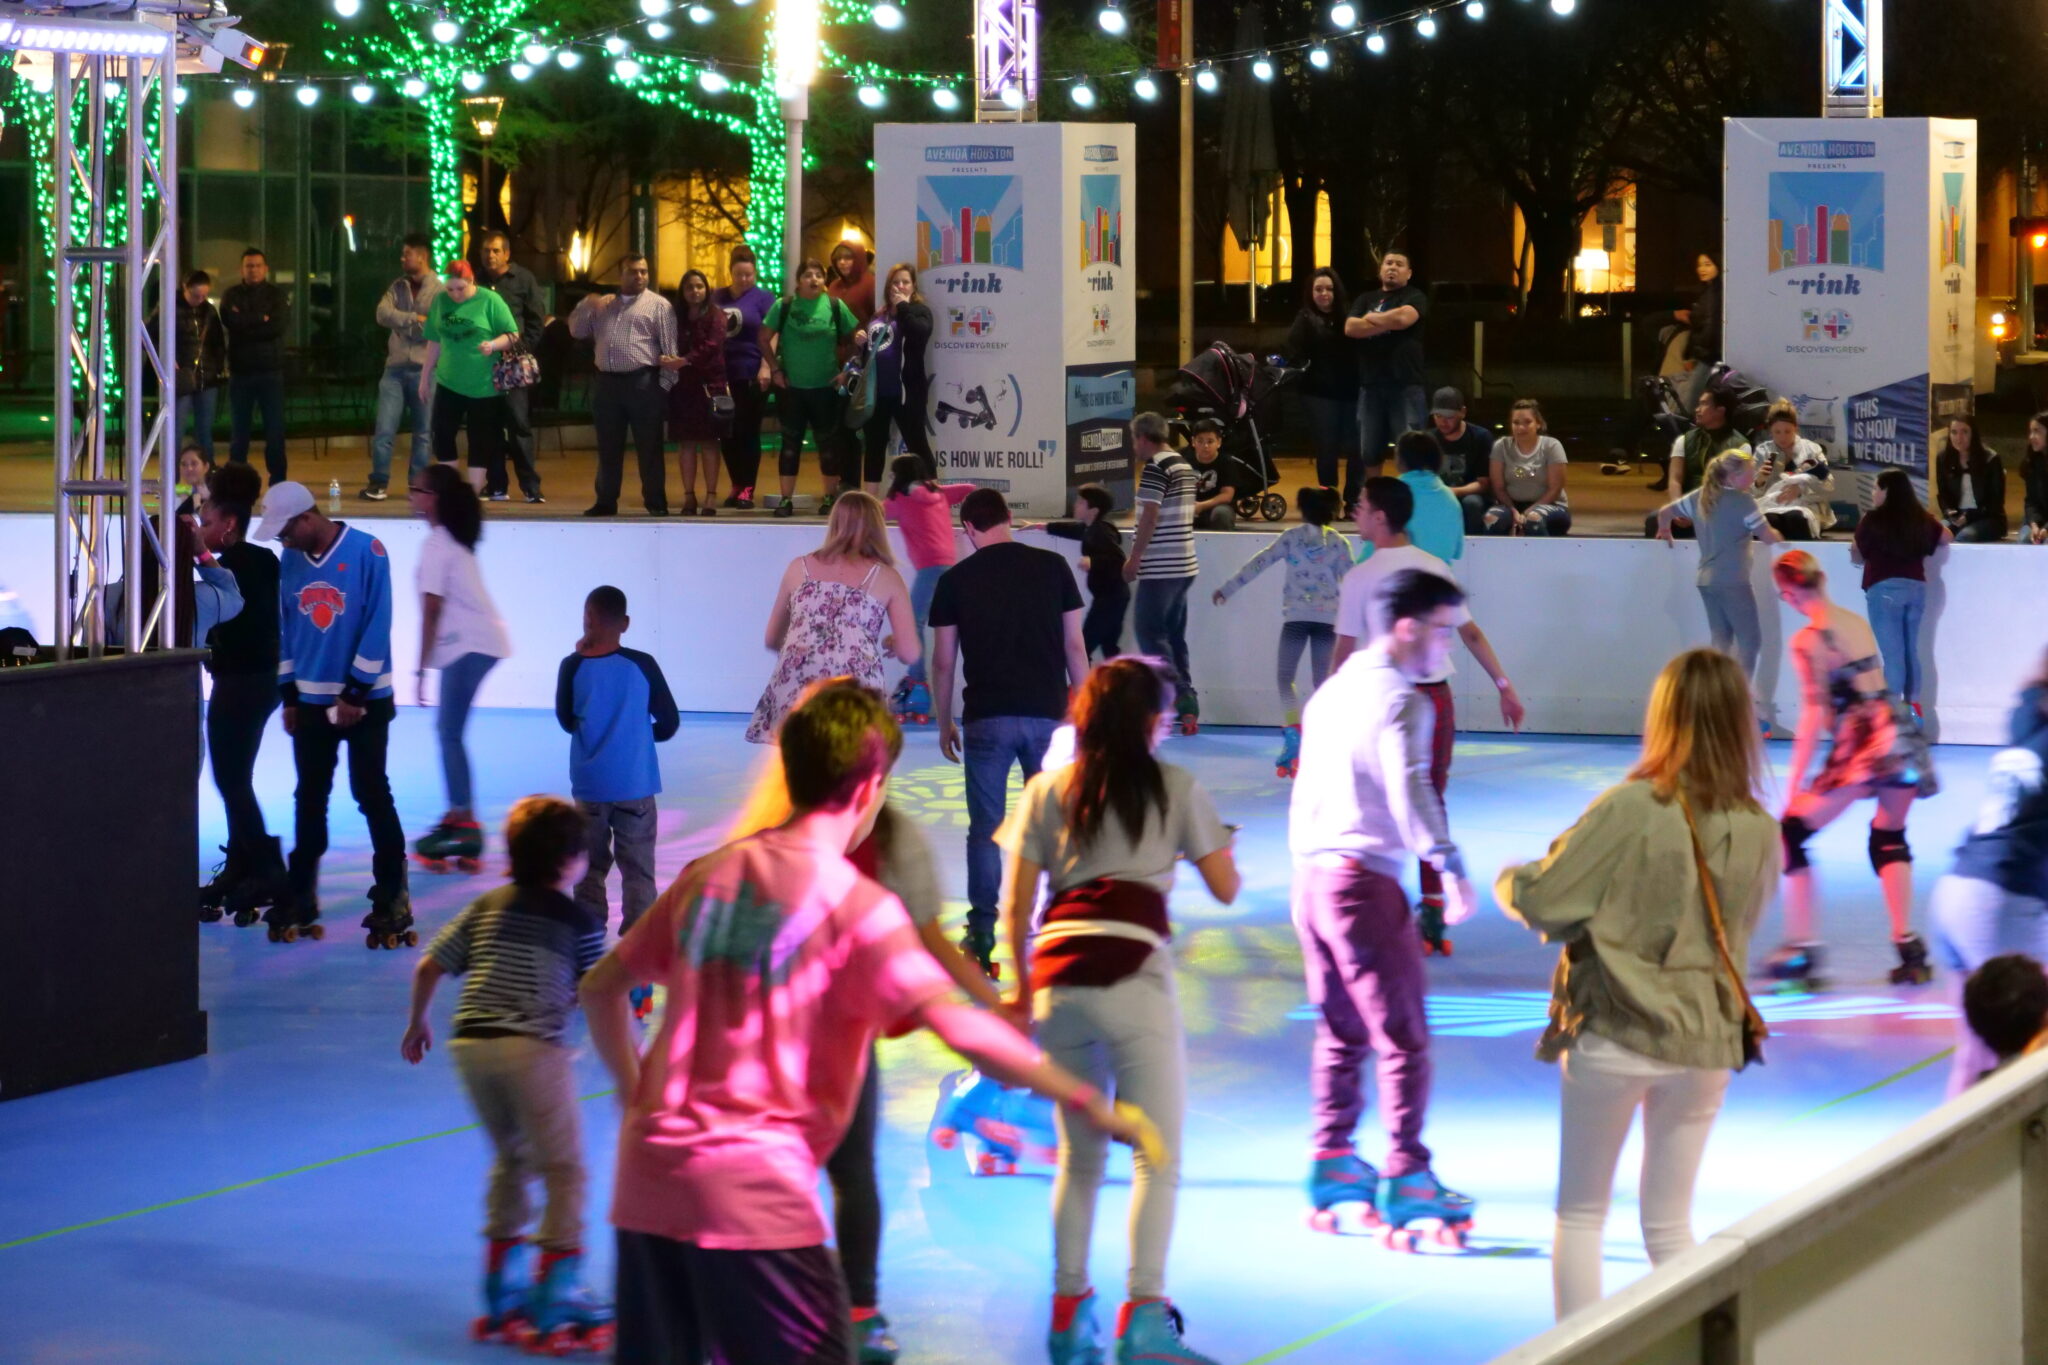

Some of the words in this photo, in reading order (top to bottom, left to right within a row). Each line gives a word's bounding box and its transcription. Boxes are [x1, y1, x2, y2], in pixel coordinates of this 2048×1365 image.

[926, 147, 968, 161] AVENIDA
[970, 147, 1014, 161] HOUSTON
[1780, 143, 1825, 157] AVENIDA
[1828, 143, 1874, 157] HOUSTON
[947, 271, 1003, 294] rink
[1092, 269, 1114, 292] rink
[1801, 272, 1861, 295] rink
[1854, 398, 1880, 419] THIS
[1854, 421, 1864, 440] IS
[1866, 417, 1897, 440] HOW
[950, 450, 980, 468] HOW
[984, 451, 1004, 468] WE
[1008, 451, 1044, 469] ROLL!
[1853, 442, 1872, 460] WE
[1875, 442, 1916, 467] ROLL!
